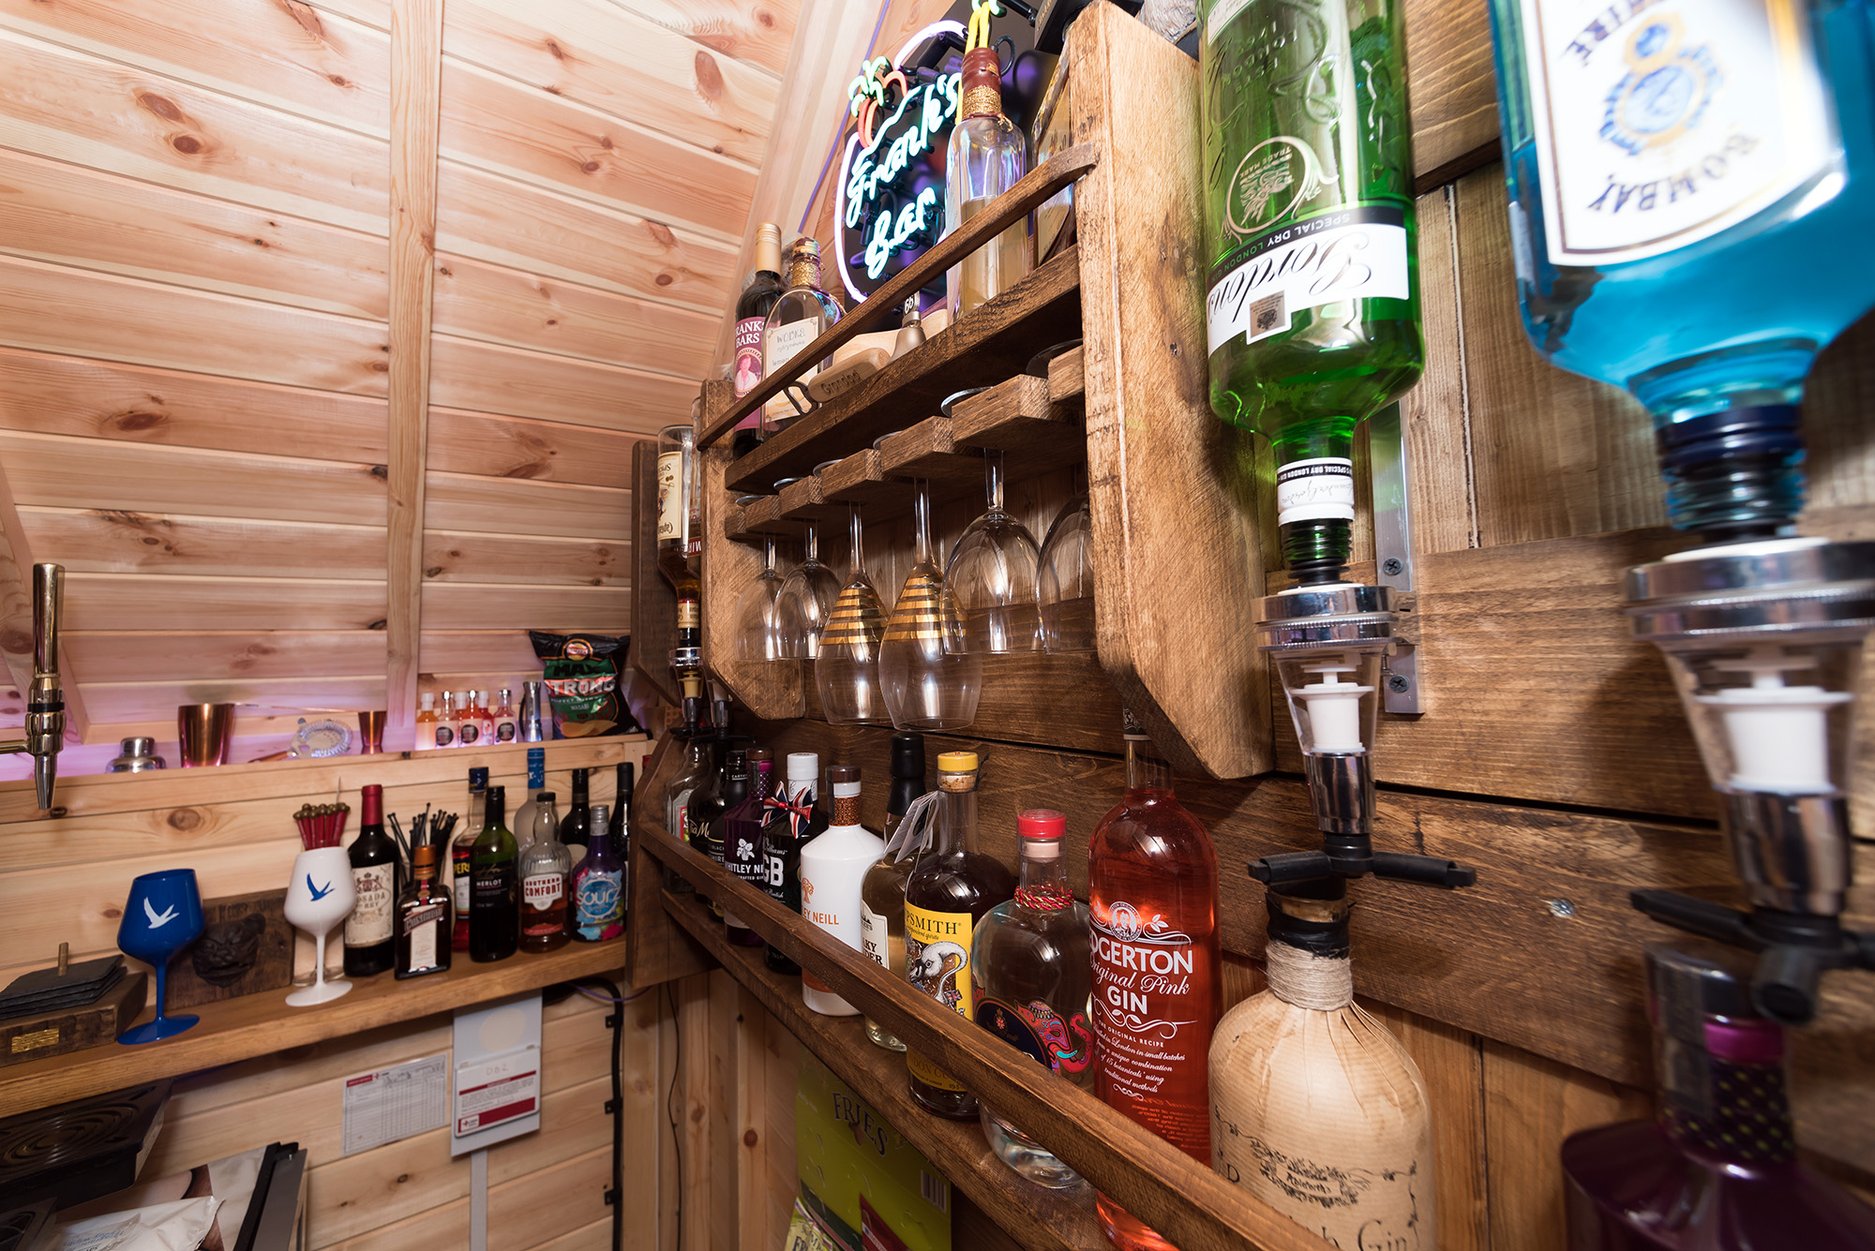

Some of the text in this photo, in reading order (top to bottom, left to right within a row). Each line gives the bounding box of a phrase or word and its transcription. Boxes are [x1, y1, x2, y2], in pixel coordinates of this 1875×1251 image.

[846, 73, 961, 229] Frank's
[1587, 131, 1759, 214] BOMBAY
[864, 187, 936, 280] Bar
[1297, 213, 1350, 236] SPECIAL
[1267, 227, 1291, 247] DRY
[1224, 242, 1264, 272] LONDON
[1288, 468, 1310, 478] LONDON
[1311, 465, 1325, 474] DRY
[1324, 465, 1347, 474] SPECIAL
[525, 877, 561, 886] SOUTHERN
[763, 854, 784, 887] GB
[476, 879, 503, 887] MERLOT
[525, 882, 561, 897] COMFORT
[812, 909, 840, 926] NEILL
[1090, 952, 1190, 995] Original Pink
[1107, 984, 1148, 1015] GIN
[1107, 1026, 1137, 1043] ORIGINAL
[1139, 1038, 1165, 1048] RECIPE
[1111, 1036, 1137, 1055] London
[1144, 1051, 1163, 1060] small
[1162, 1052, 1186, 1061] batches
[1111, 1051, 1131, 1064] unique
[1131, 1058, 1173, 1073] combination
[1104, 1067, 1159, 1093] traditional methods
[1145, 1074, 1165, 1086] using
[832, 1092, 888, 1157] FRIES
[1358, 1219, 1408, 1251] Gin
